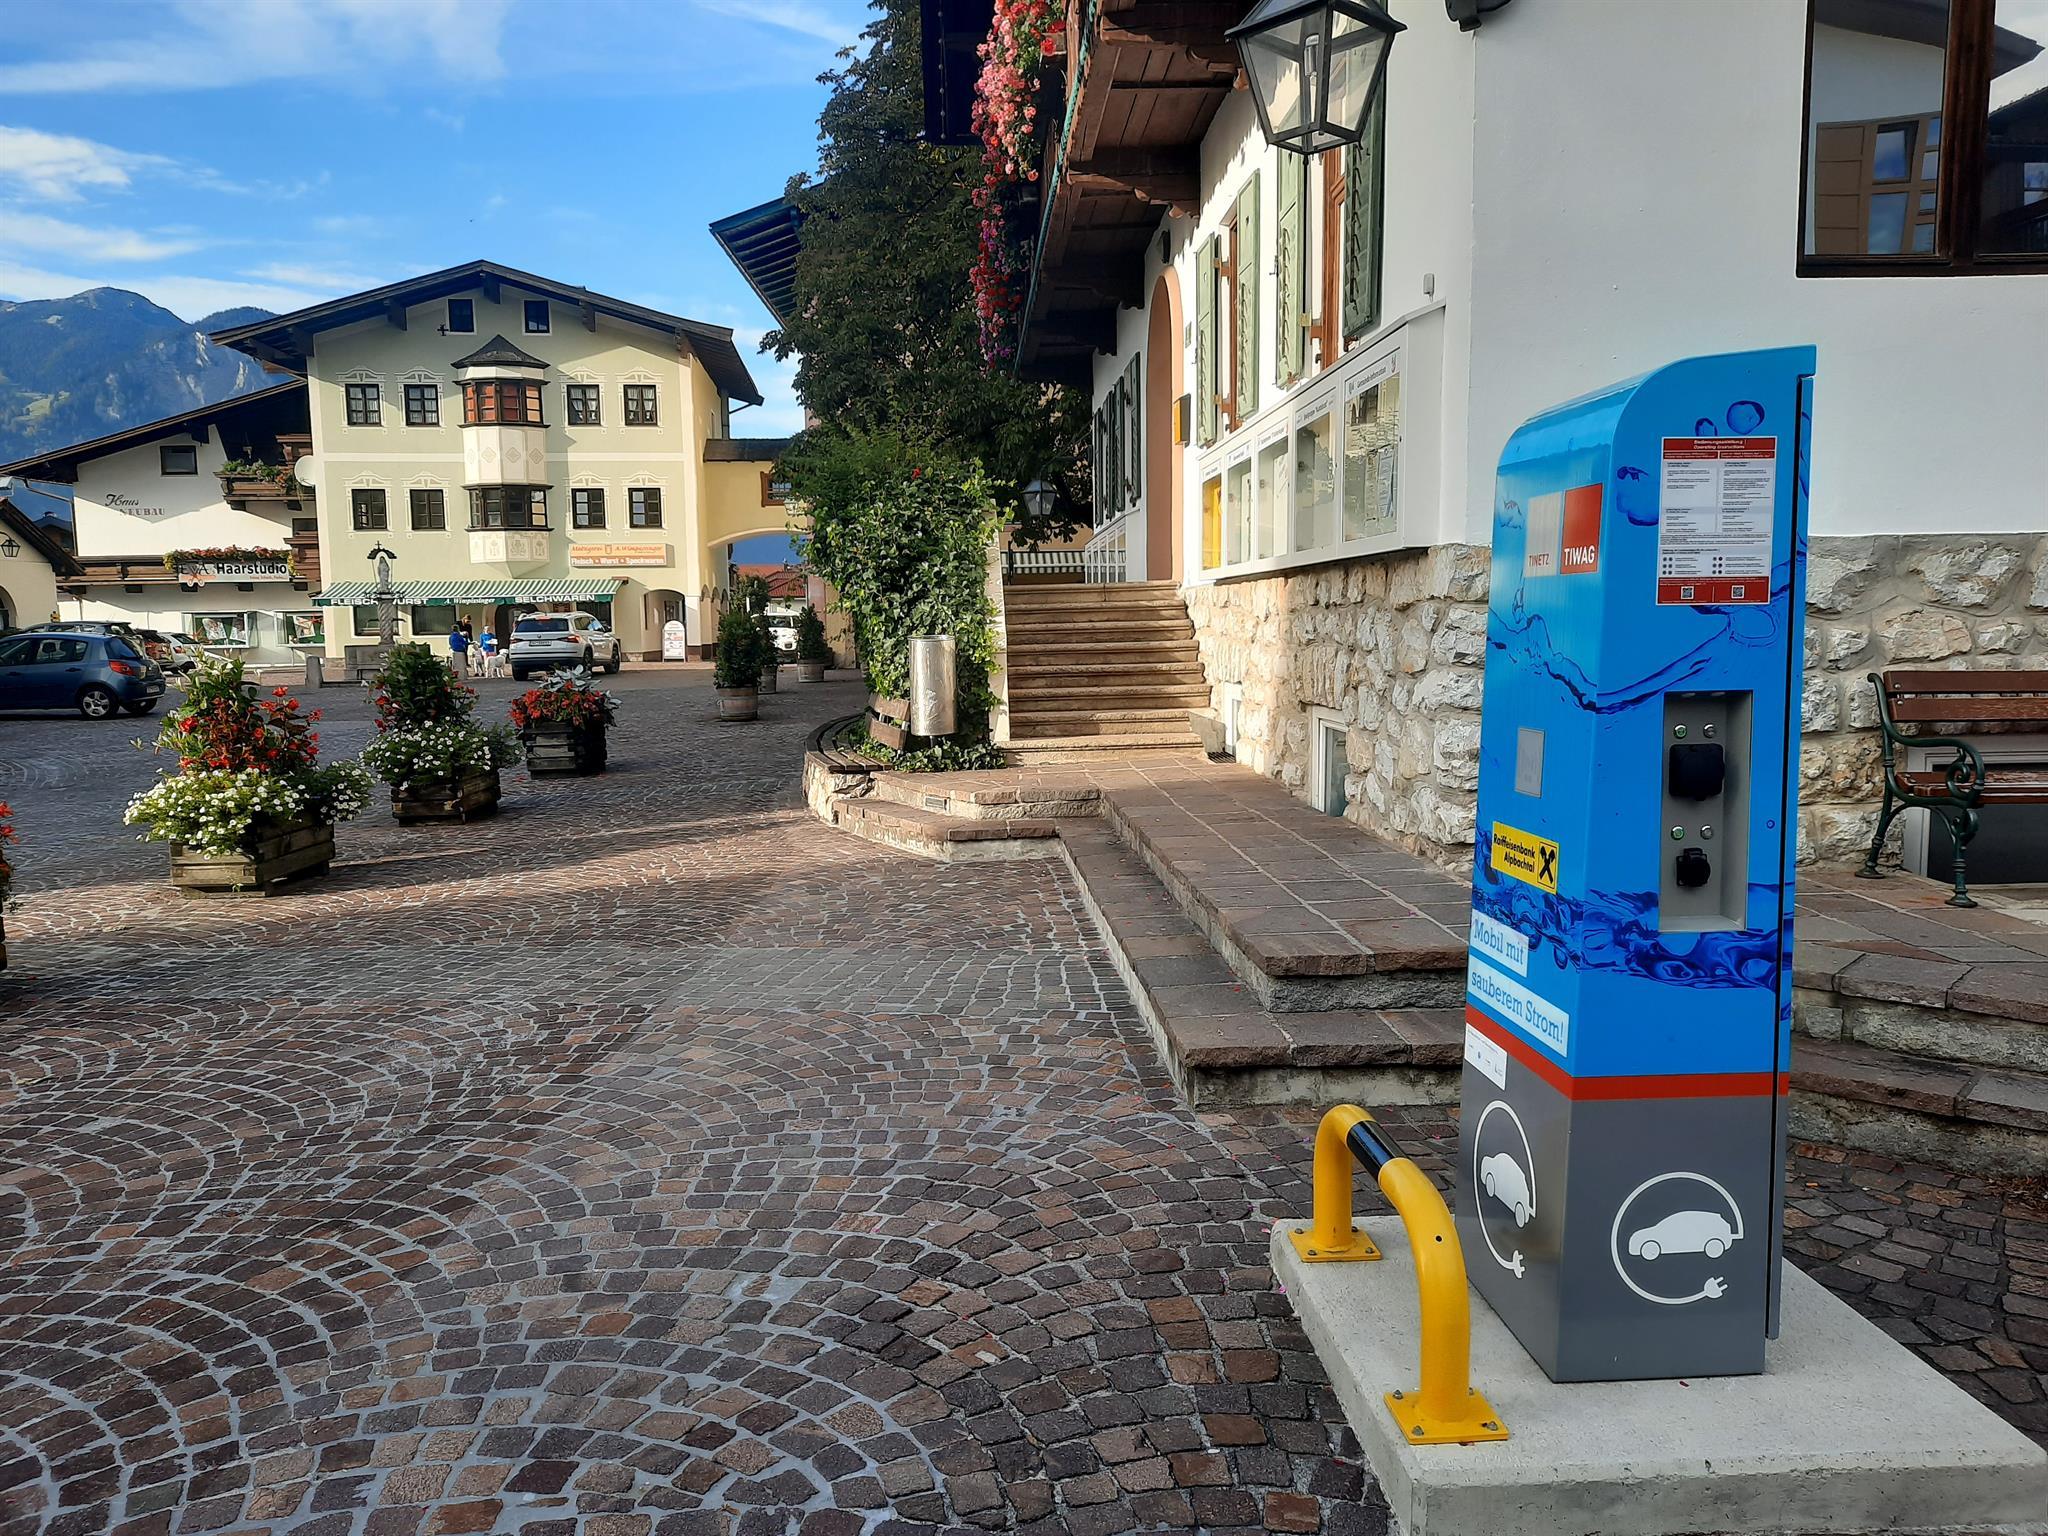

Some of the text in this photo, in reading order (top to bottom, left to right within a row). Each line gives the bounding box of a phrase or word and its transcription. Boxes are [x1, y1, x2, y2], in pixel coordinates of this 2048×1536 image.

[105, 493, 139, 507] Haus
[571, 557, 593, 565] Fleisch
[1528, 553, 1550, 567] TINETZ
[1564, 545, 1595, 566] TIWAG
[216, 562, 287, 575] Haarstudio
[514, 594, 595, 604] SELCHWAREN
[1493, 833, 1536, 859] Raiffeisenbank
[1504, 850, 1535, 873] Alpbachtal
[1474, 919, 1524, 966] Mobil mit
[1471, 971, 1523, 1017] sauberem
[1525, 1000, 1564, 1044] Strom!
